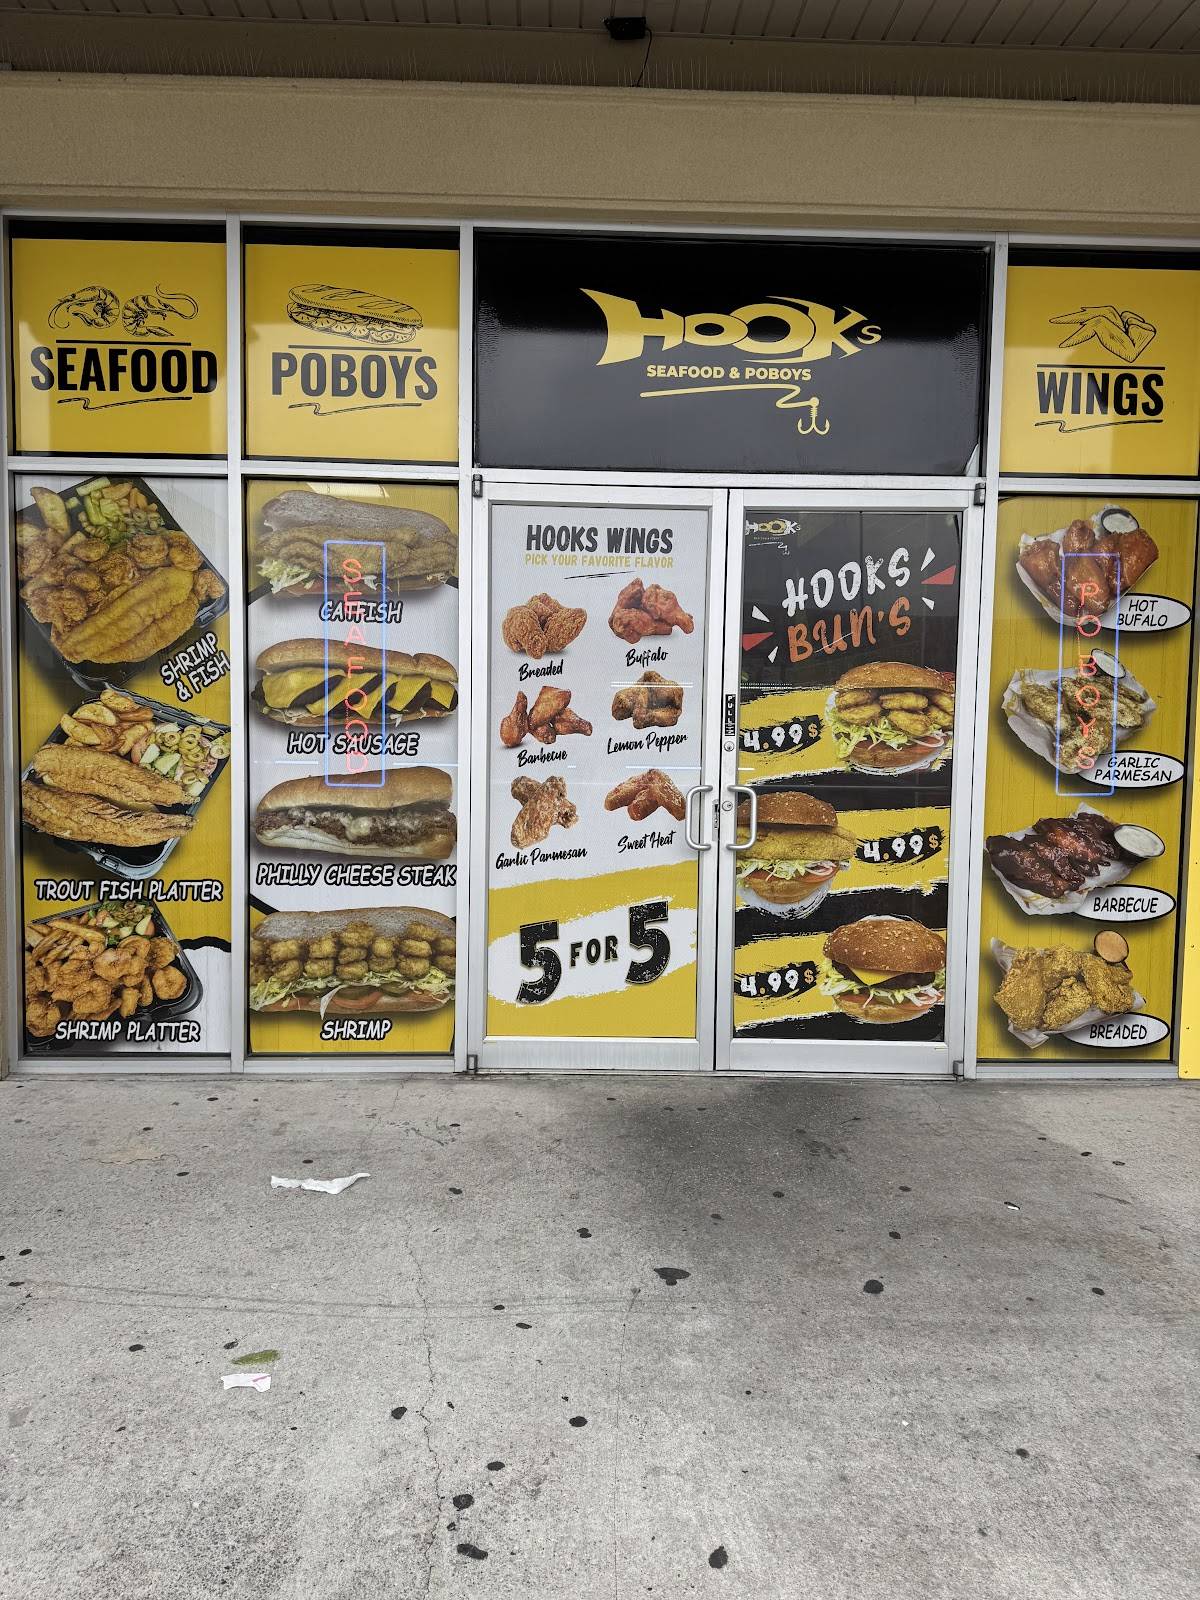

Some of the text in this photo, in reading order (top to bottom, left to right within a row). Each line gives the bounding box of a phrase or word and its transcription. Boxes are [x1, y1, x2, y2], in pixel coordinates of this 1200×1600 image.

[31, 346, 218, 394] SEAFOOD
[272, 352, 438, 401] POBOYS
[646, 365, 812, 381] SEAFOOD & POBOYS
[1037, 371, 1165, 417] WINGS
[526, 524, 674, 554] HOOKS WINGS
[525, 553, 674, 569] PICK YOUR FAVORITE FLAVOR
[782, 547, 911, 617] HOOKS
[319, 601, 402, 623] CATFISH
[1128, 600, 1158, 613] HOT
[1116, 614, 1168, 627] BUFALO
[161, 632, 217, 684] SHRIMP
[342, 558, 369, 774] SEAFOOD
[625, 647, 668, 667] Buffalo
[176, 651, 231, 700] & FISH
[519, 659, 564, 681] Breaded
[1076, 582, 1101, 770] POBOYS
[288, 733, 419, 755] HOT SAUSAGE
[606, 732, 689, 754] Lemon Pepper
[517, 748, 568, 767] Barbecue
[1107, 756, 1161, 769] GARLIC
[1094, 769, 1172, 782] PARMESAN
[617, 831, 676, 853] Sweet Heat
[495, 847, 588, 870] Garlic Parmesan
[257, 863, 457, 886] PHILLY CHEESE STEAK
[35, 880, 224, 901] TROUT FISH PLATTER
[1093, 897, 1159, 913] BARBECUE
[515, 900, 671, 1005] 5 FOR 5
[55, 1020, 201, 1042] SHRIMP PLATTER
[321, 1020, 392, 1041] SHRIMP
[1089, 1023, 1148, 1040] BREADED
